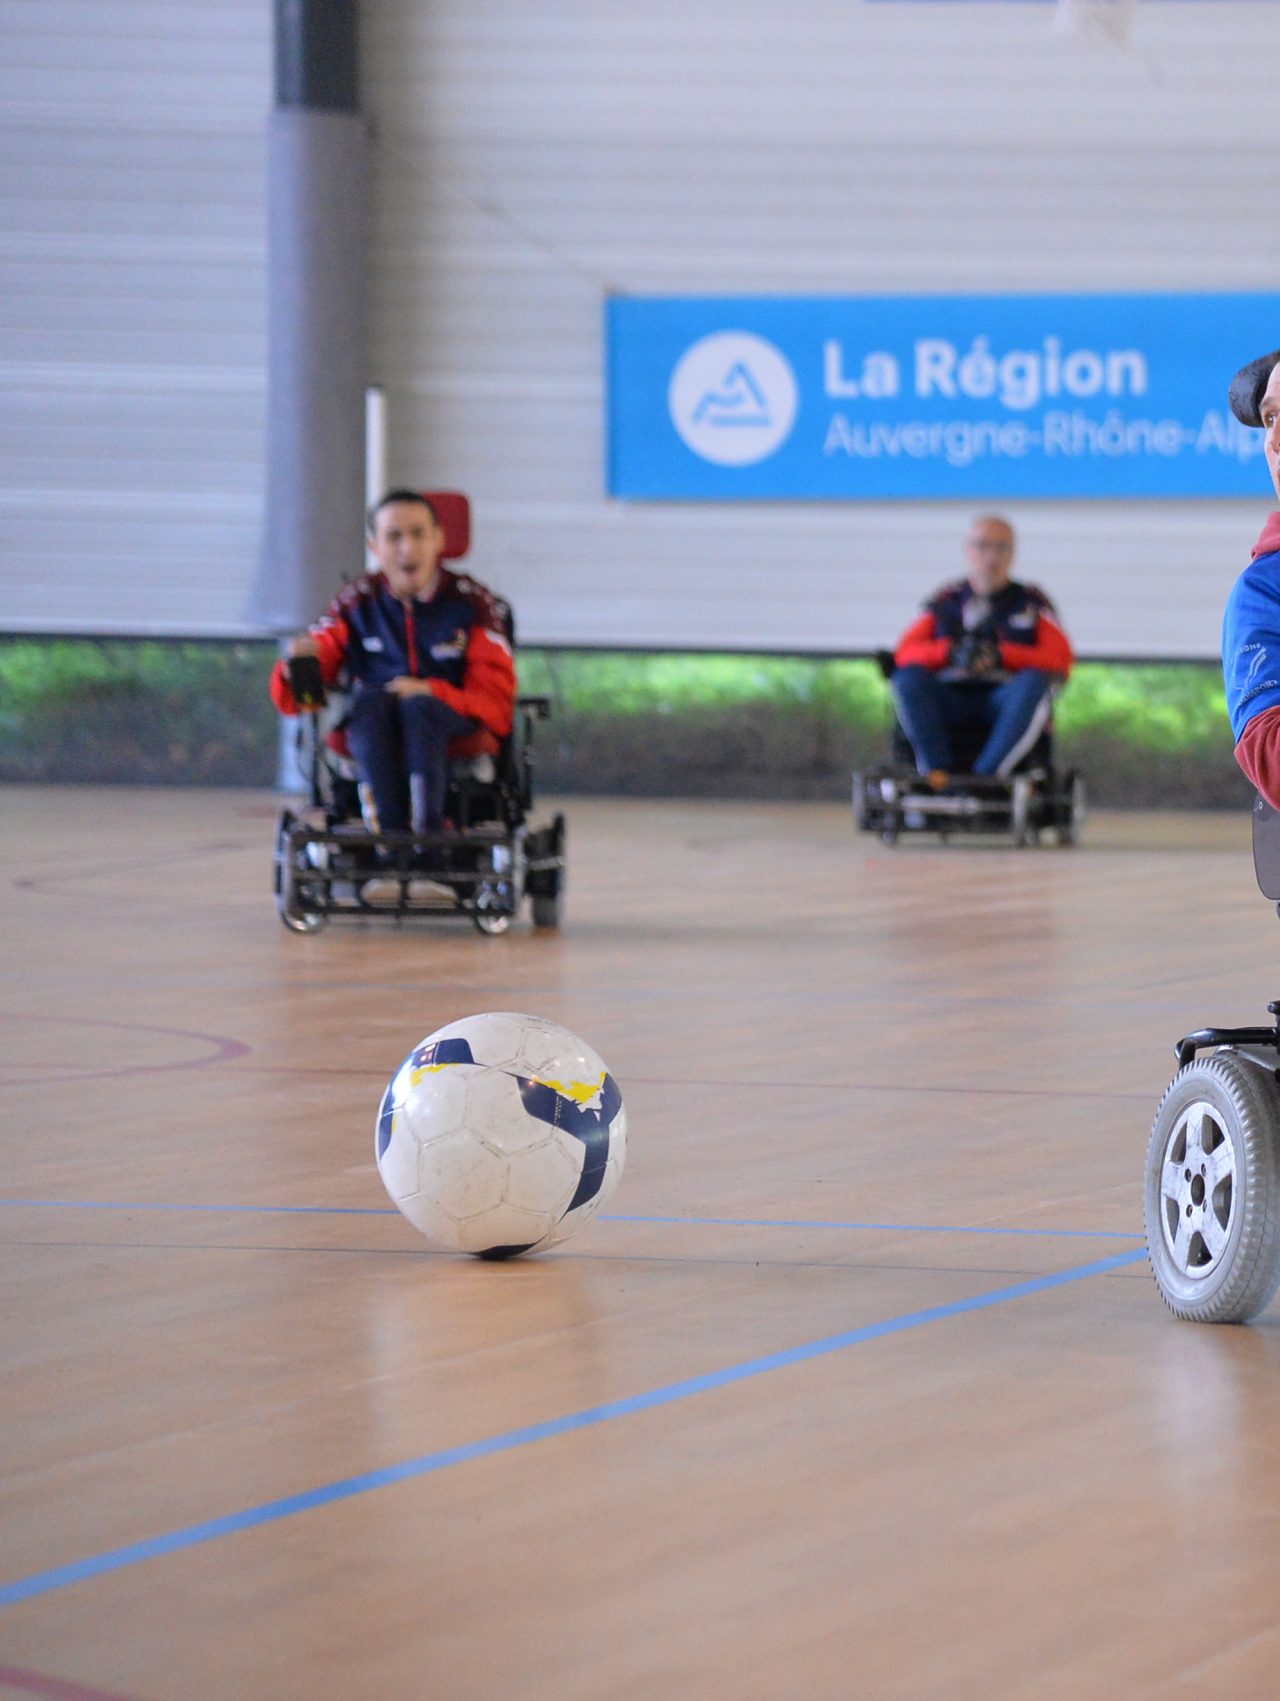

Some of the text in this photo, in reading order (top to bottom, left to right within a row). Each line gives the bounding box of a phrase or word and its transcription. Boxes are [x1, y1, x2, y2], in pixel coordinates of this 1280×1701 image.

[823, 334, 1147, 411] La Région
[824, 410, 1266, 466] Auvergne-Rhône-Alp
